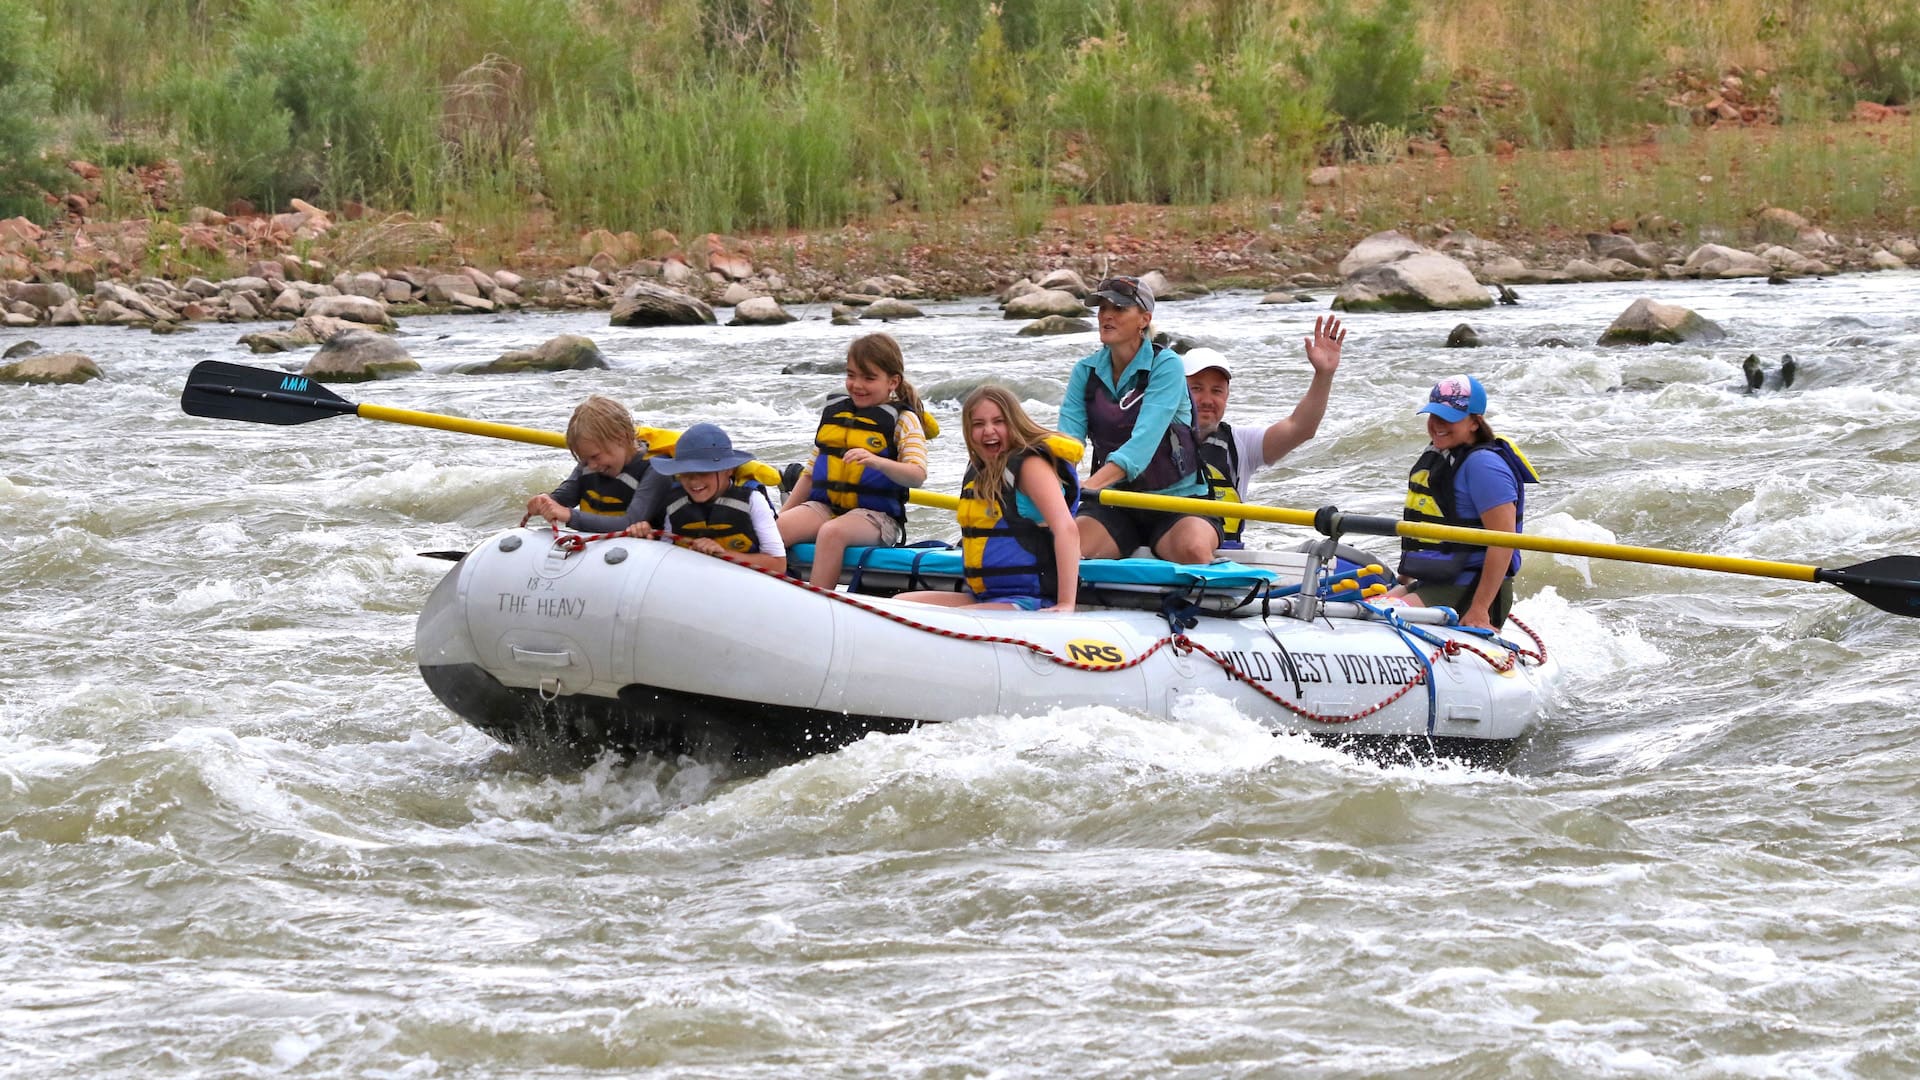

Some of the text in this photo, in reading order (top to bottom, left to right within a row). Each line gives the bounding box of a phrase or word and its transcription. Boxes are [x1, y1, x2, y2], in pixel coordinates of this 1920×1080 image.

[498, 593, 586, 619] THE HEAVY
[1068, 644, 1122, 663] NRS
[1214, 651, 1426, 685] WILD WEST VOYAGES
